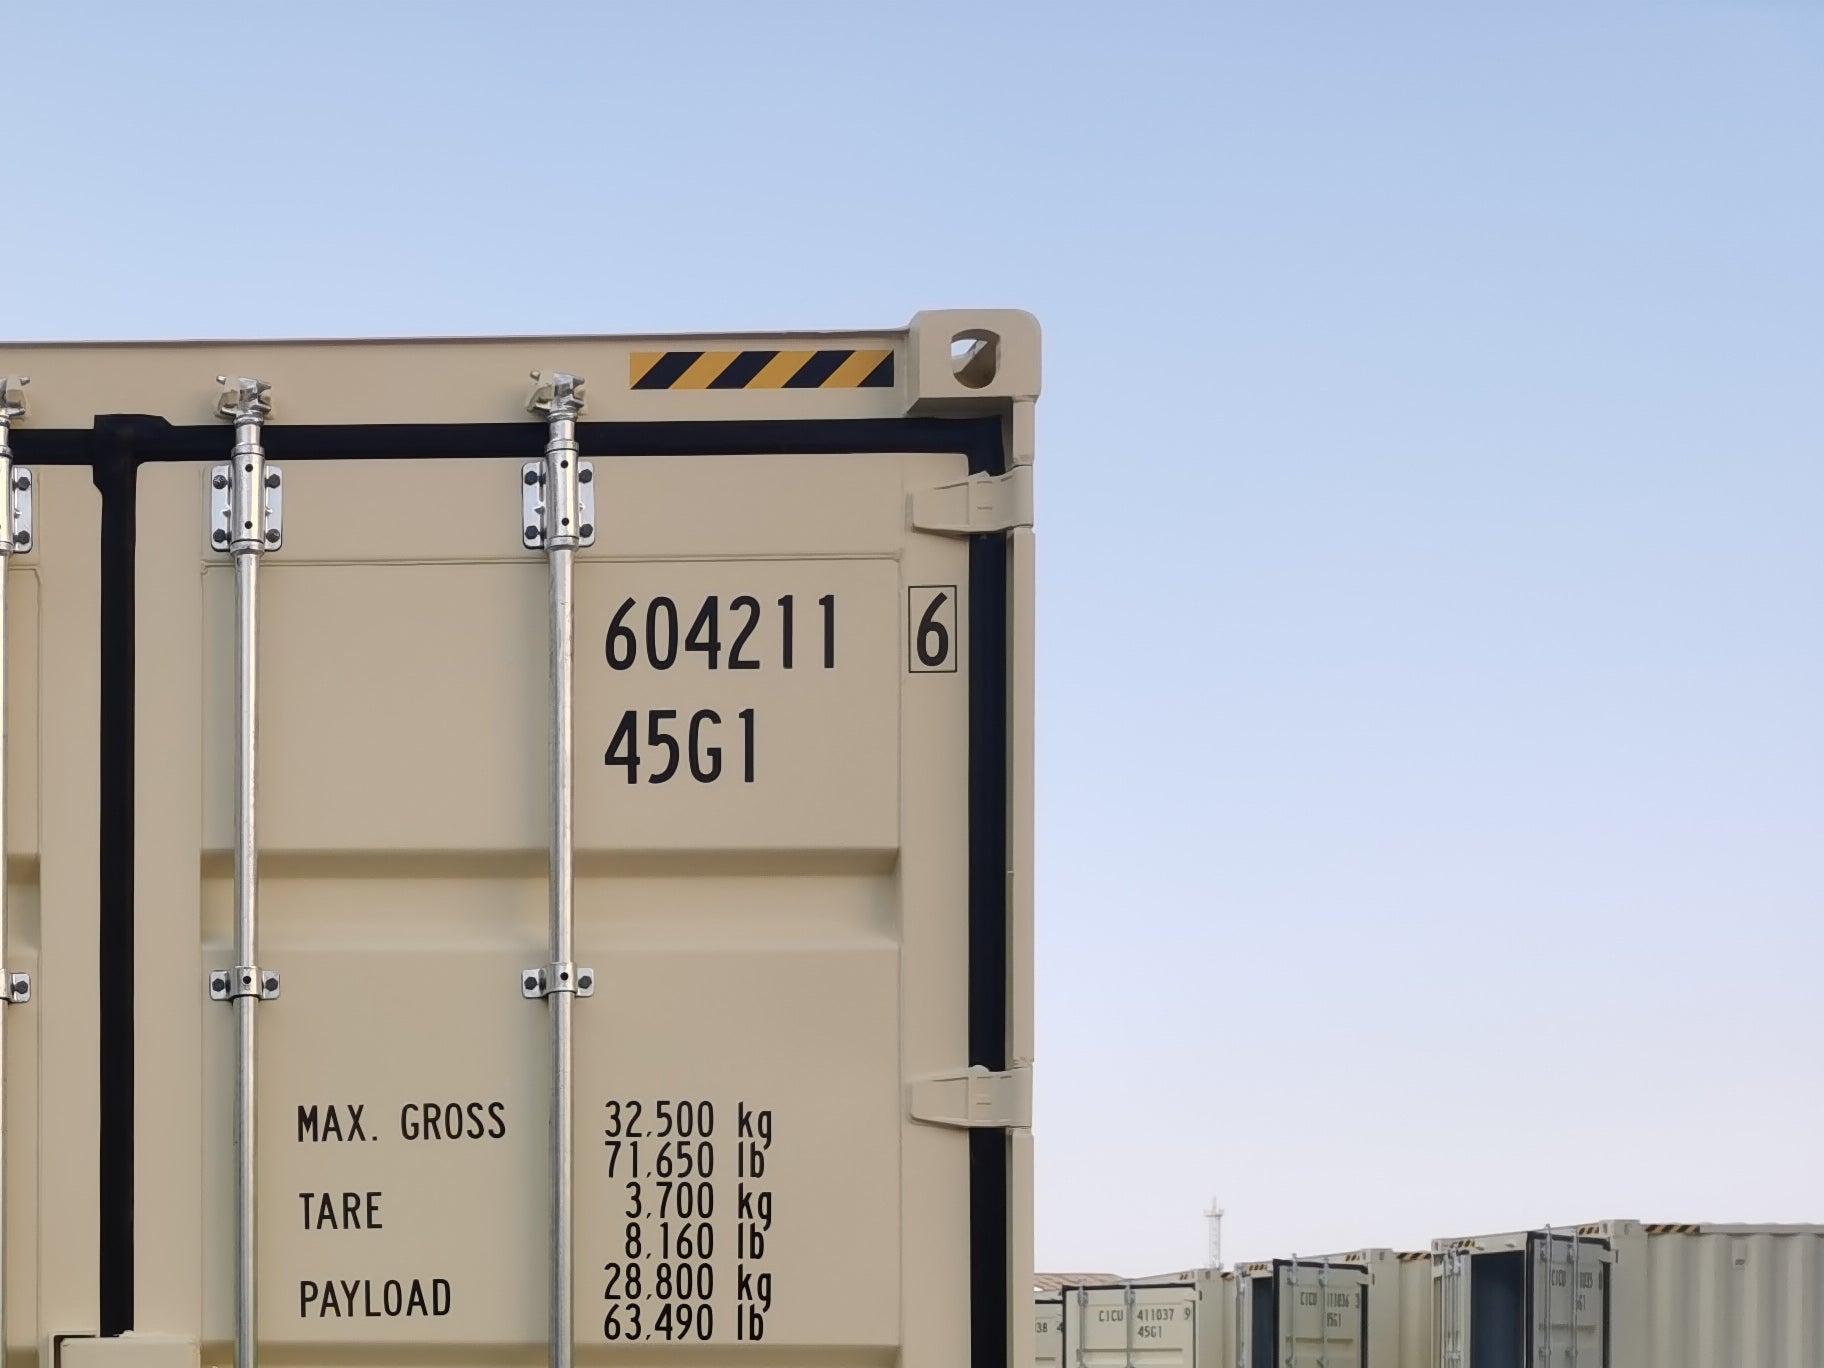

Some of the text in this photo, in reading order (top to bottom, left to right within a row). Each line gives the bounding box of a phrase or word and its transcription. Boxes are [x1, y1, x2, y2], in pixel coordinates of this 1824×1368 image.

[605, 592, 949, 671] 604211 6
[604, 708, 755, 784] 45G1
[297, 1104, 378, 1143] MAX.
[400, 1101, 506, 1141] GROSS
[737, 1101, 773, 1150] kg
[737, 1142, 766, 1178] lb
[298, 1191, 383, 1230] TARE
[737, 1182, 773, 1232] kg
[737, 1223, 766, 1259] lb
[300, 1278, 451, 1318] PAYLOAD
[737, 1264, 773, 1313] kg
[737, 1304, 766, 1341] lb
[1099, 1309, 1191, 1322] CICU 411037 9
[1138, 1325, 1162, 1338] 45G1
